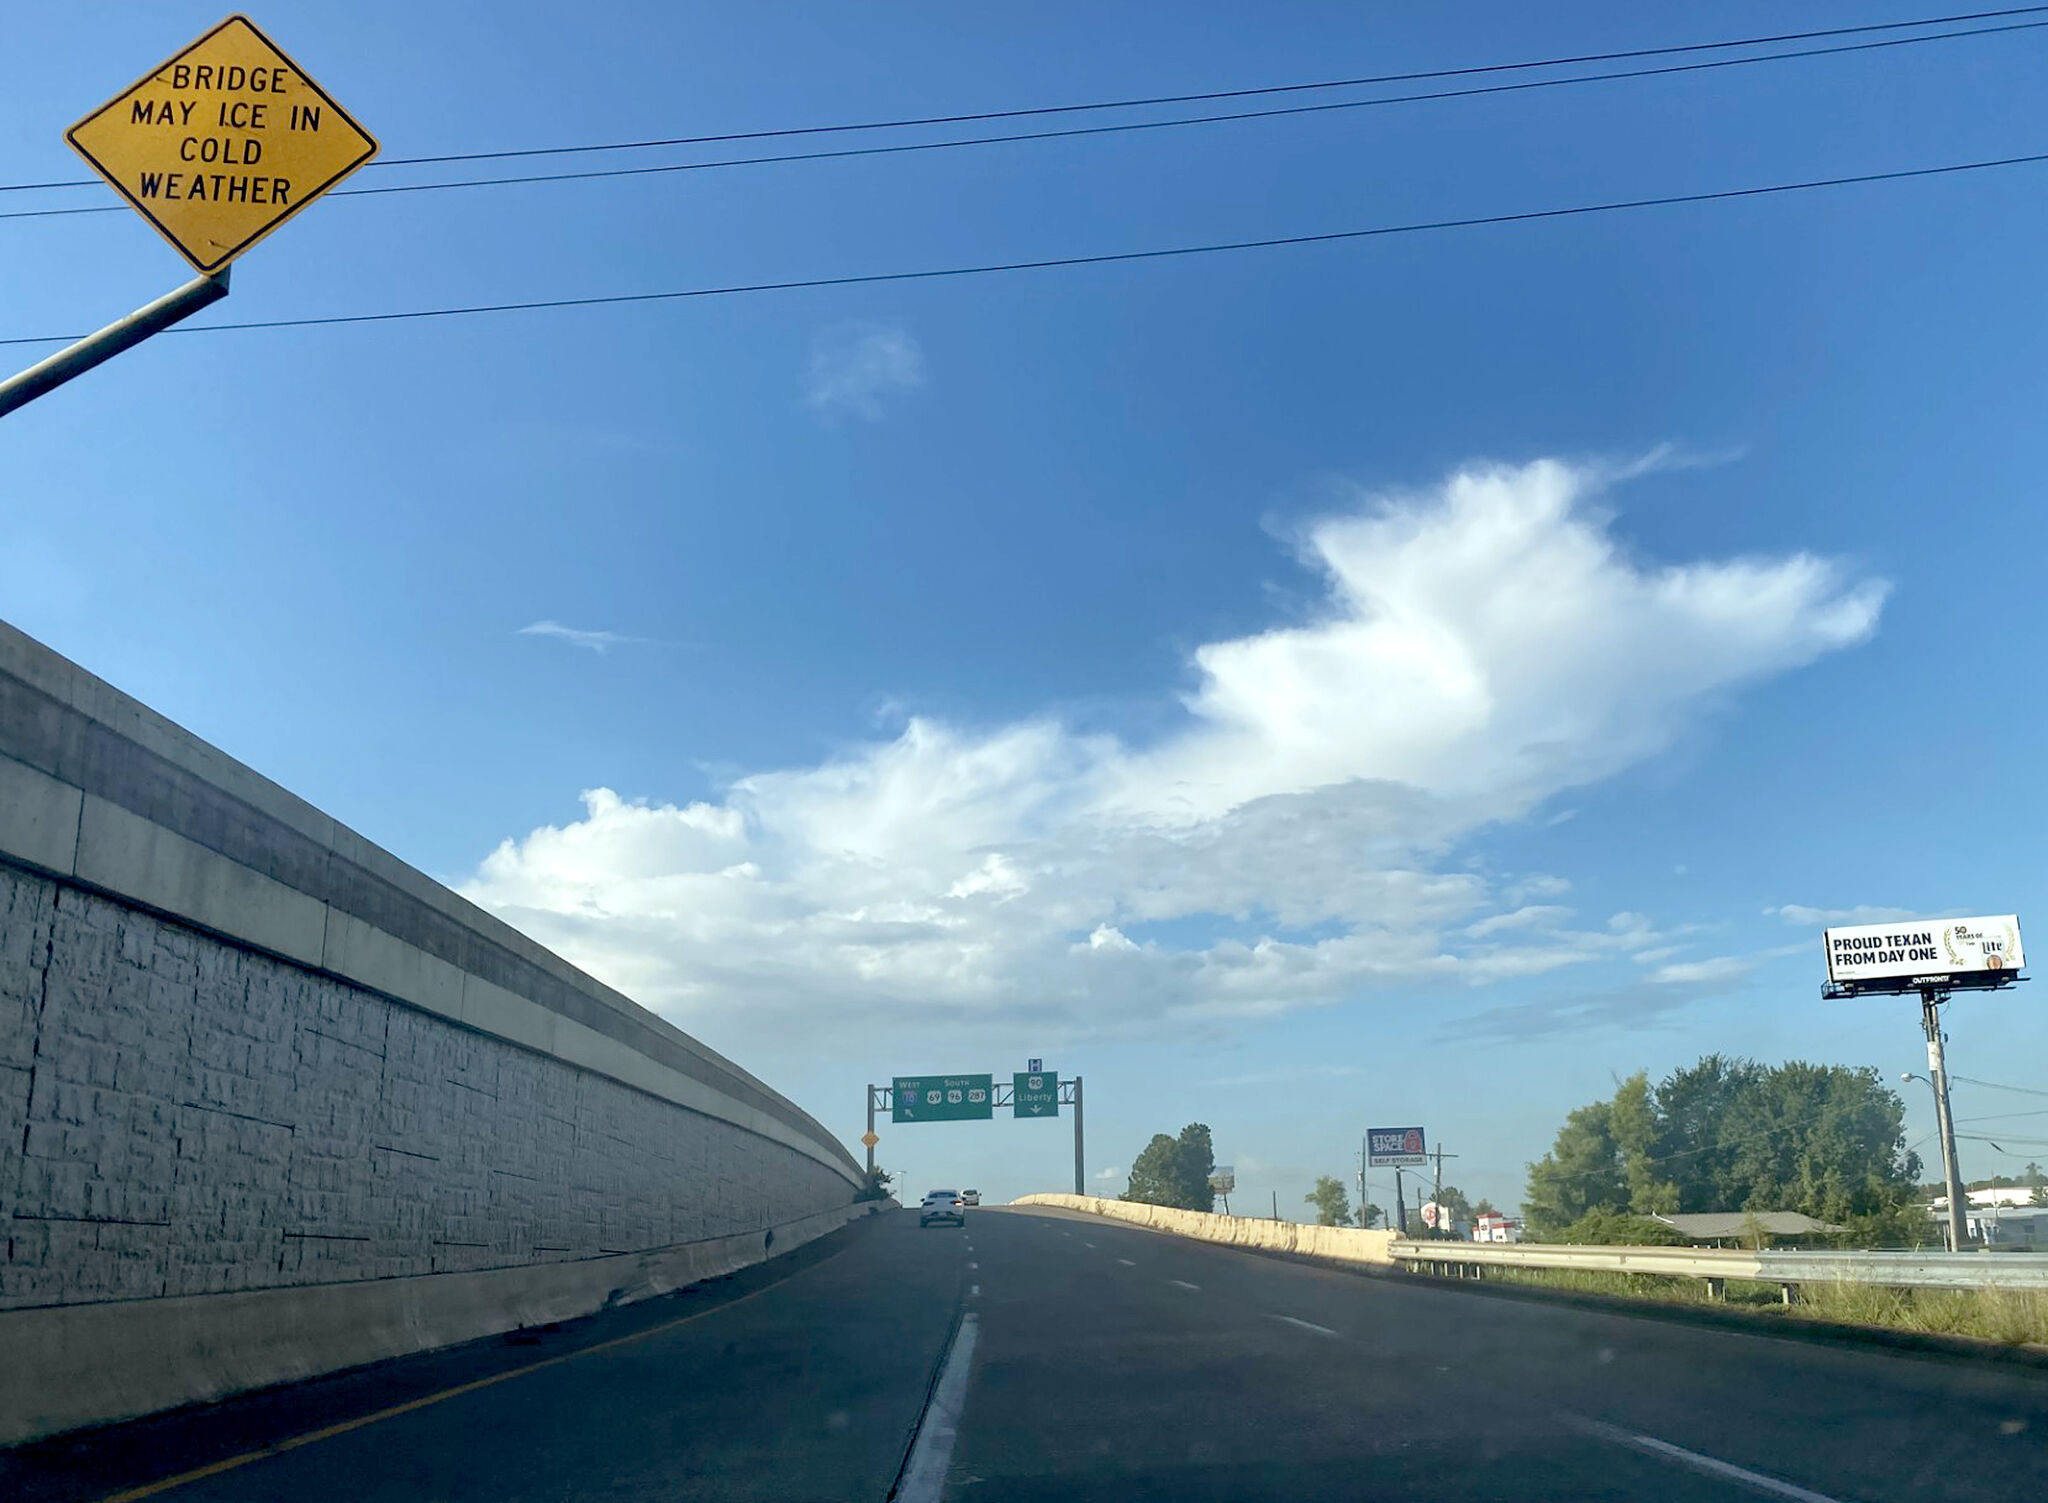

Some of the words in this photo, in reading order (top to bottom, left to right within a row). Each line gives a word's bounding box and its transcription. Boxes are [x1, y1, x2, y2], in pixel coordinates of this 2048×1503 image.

[172, 65, 288, 93] BRIDGE
[131, 101, 196, 125] MAY
[219, 103, 267, 129] ICE
[290, 106, 320, 132] IN
[180, 137, 262, 165] COLD
[140, 173, 290, 204] WEATHER
[1954, 926, 1967, 935] 50
[1833, 937, 1882, 951] PROUD
[1885, 933, 1932, 948] TEXAN
[1835, 952, 1876, 966] FROM
[1879, 949, 1905, 963] DAY
[1908, 947, 1938, 961] ONE
[1030, 1079, 1042, 1087] 90
[929, 1092, 940, 1101] 69
[950, 1091, 960, 1100] 96
[969, 1091, 985, 1100] 287
[1019, 1094, 1052, 1103] Liberty
[1374, 1143, 1403, 1151] SPACE
